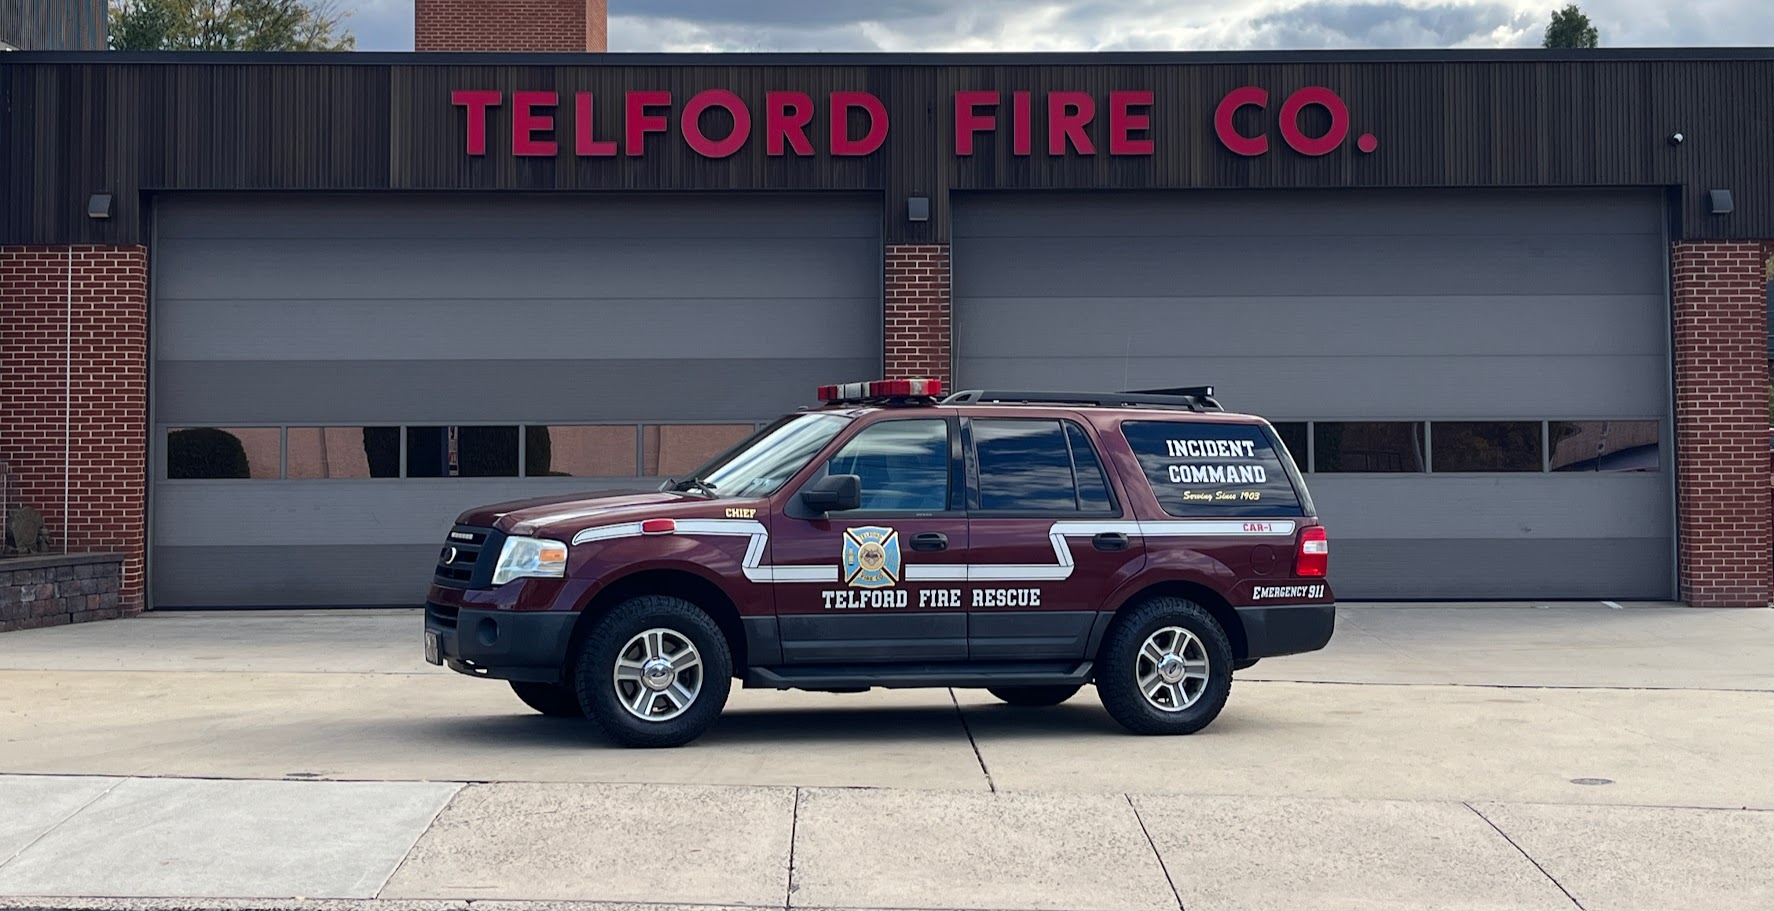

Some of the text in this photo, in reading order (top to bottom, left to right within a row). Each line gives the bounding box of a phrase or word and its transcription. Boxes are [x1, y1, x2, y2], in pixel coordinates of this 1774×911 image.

[451, 86, 1378, 158] TELFORD FIRE CO.
[1166, 439, 1255, 457] INCIDENT
[1168, 465, 1267, 483] COMMAND
[1183, 490, 1261, 502] Serving Since 1903
[725, 507, 757, 519] CHIEF
[1242, 523, 1273, 532] CAR-1
[821, 588, 1041, 609] TELFORD FIRE RESCUE
[1307, 584, 1325, 599] 911
